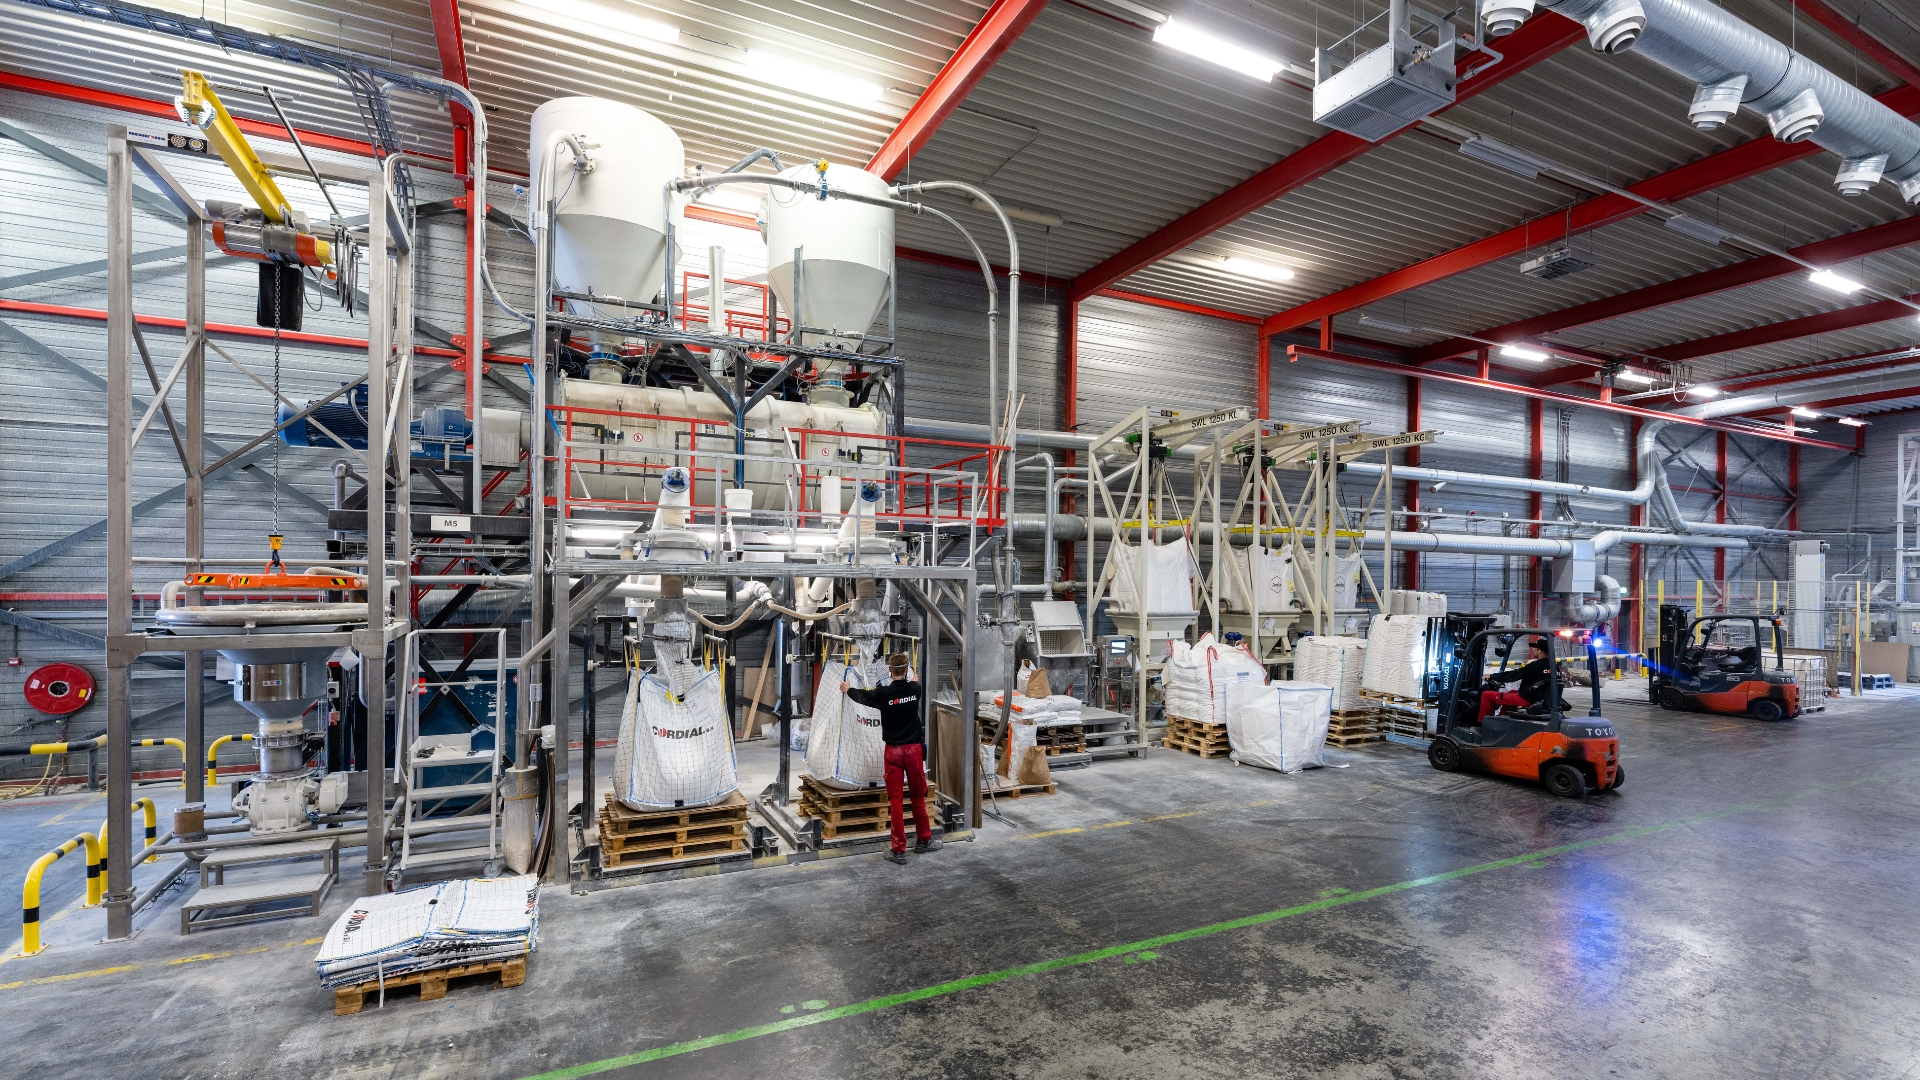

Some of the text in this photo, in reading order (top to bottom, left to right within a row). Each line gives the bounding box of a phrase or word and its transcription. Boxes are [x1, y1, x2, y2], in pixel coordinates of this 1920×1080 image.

[1191, 417, 1207, 429] SWL
[1209, 412, 1226, 424] 1250
[1299, 430, 1316, 441] SWL
[1319, 426, 1337, 437] 1250
[1372, 433, 1425, 449] SWL 1250 KG
[1442, 665, 1450, 690] TOYOTA
[888, 695, 917, 705] CORDIAL
[856, 713, 882, 727] CORD
[652, 725, 703, 739] CORDIAL
[1585, 726, 1615, 737] TOYO
